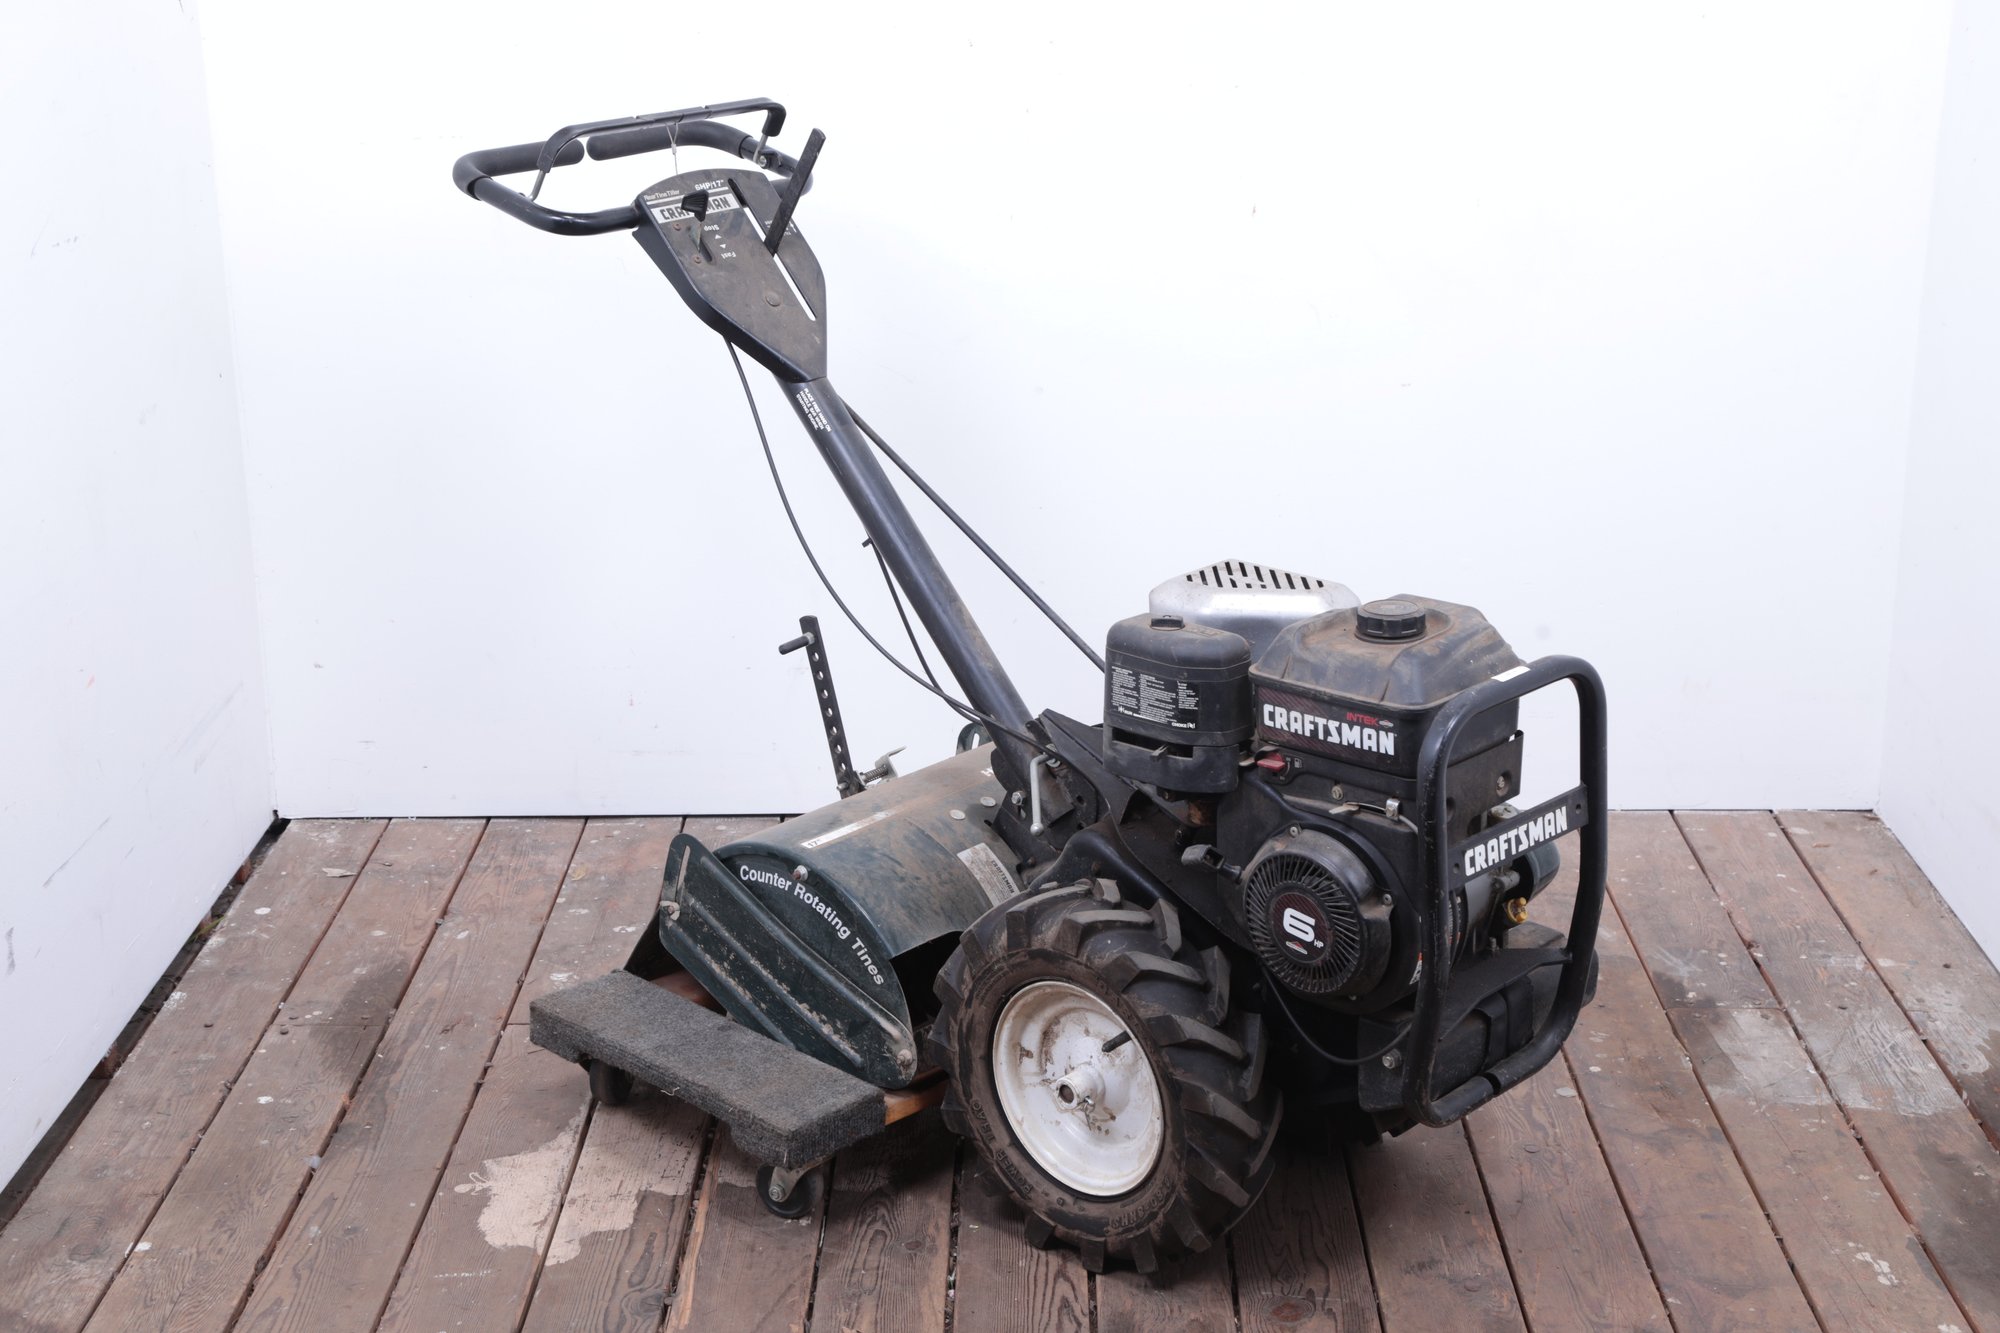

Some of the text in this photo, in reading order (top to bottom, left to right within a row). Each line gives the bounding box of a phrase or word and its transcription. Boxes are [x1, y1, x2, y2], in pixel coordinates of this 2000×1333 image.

[703, 224, 720, 232] Stop
[720, 251, 737, 259] Fast
[1263, 703, 1395, 756] CRAFTSMAN
[1346, 711, 1379, 727] INTEK
[1464, 806, 1568, 877] CRAFTSMAN
[991, 860, 1016, 894] CRAFTSMAN
[740, 865, 884, 985] Counter Rotating Tines
[1282, 907, 1316, 943] 6
[1313, 939, 1324, 949] HP
